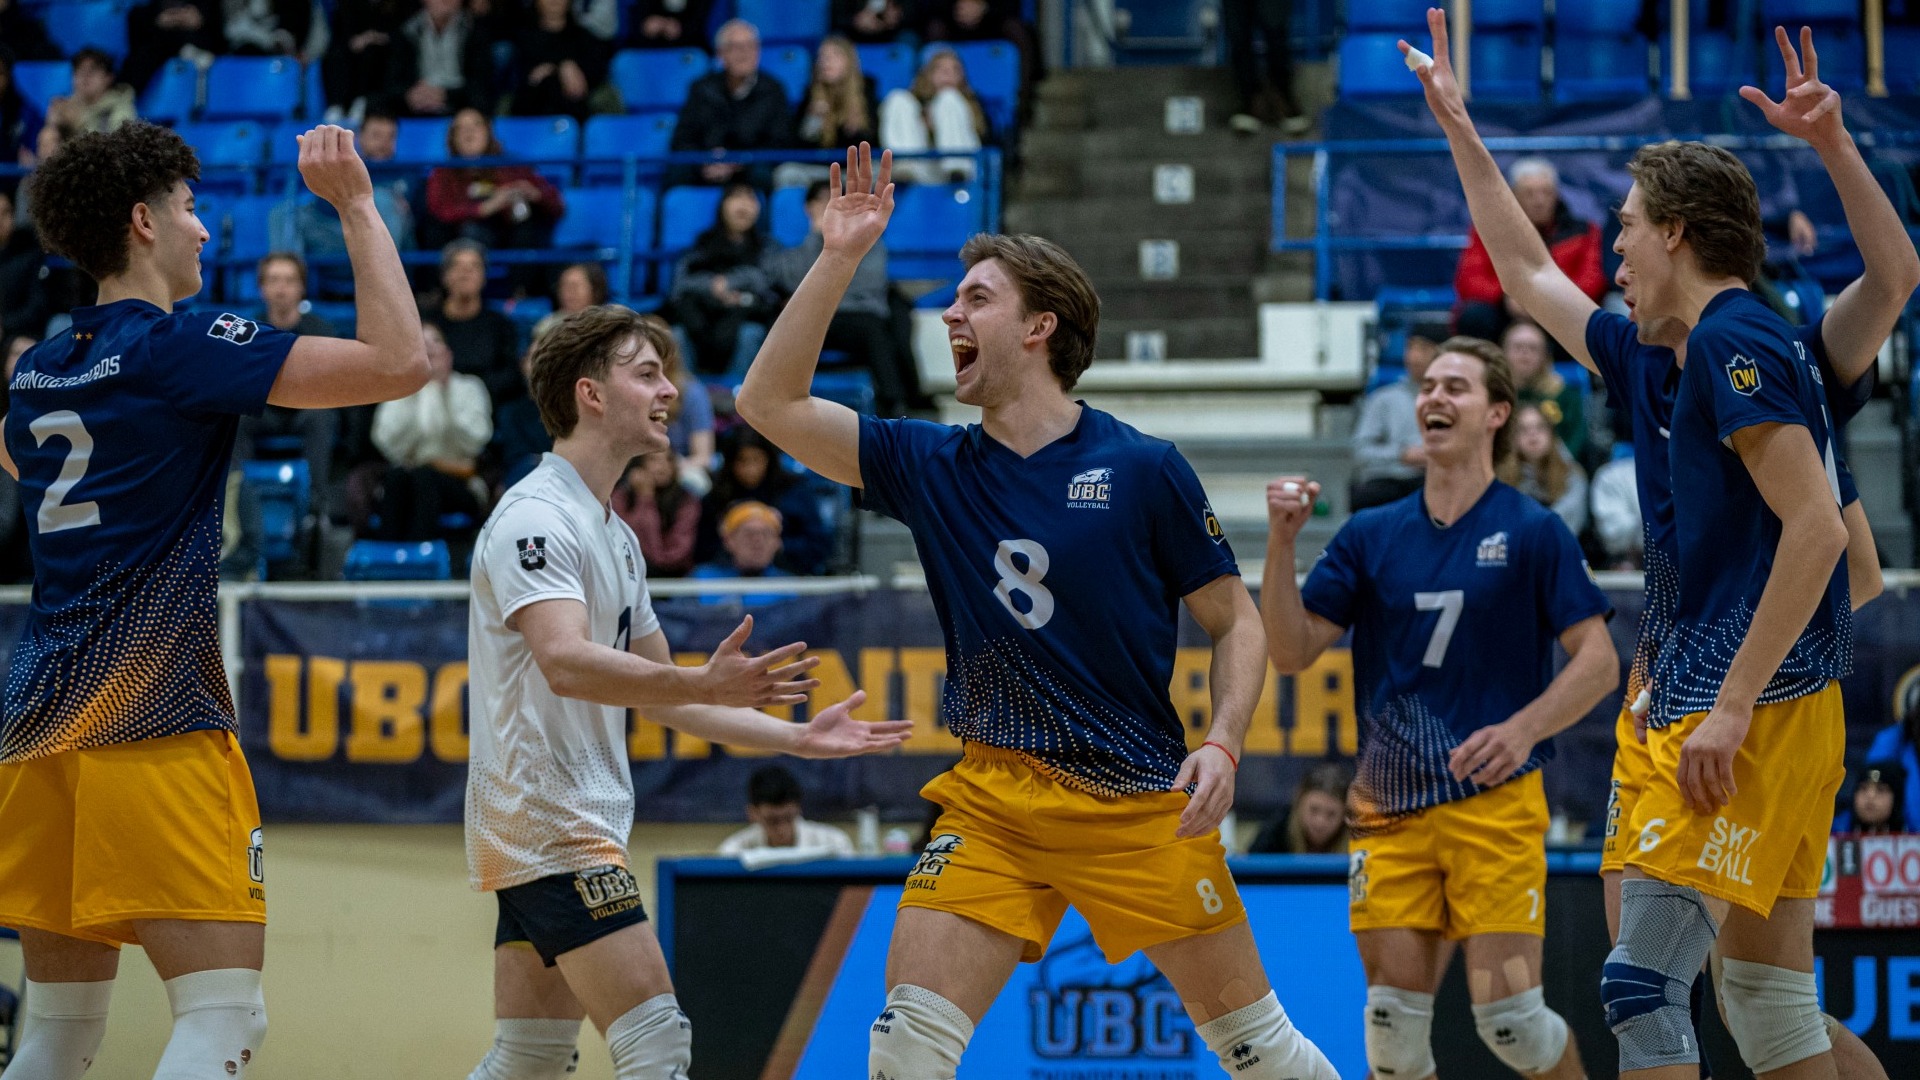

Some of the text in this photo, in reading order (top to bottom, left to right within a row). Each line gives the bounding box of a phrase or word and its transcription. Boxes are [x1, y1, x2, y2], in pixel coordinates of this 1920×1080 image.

[1731, 367, 1757, 391] CW
[28, 409, 102, 535] 2
[1066, 501, 1111, 510] VOLLEYBALL
[1068, 482, 1112, 501] UBC
[518, 548, 546, 560] SPORTS
[994, 538, 1055, 630] 8
[1413, 589, 1465, 669] 7
[1638, 817, 1667, 853] 6
[1708, 815, 1763, 854] SKY
[1696, 841, 1753, 886] BALL
[1195, 877, 1224, 915] 8
[1030, 987, 1190, 1059] UBC
[1235, 1054, 1260, 1071] errea
